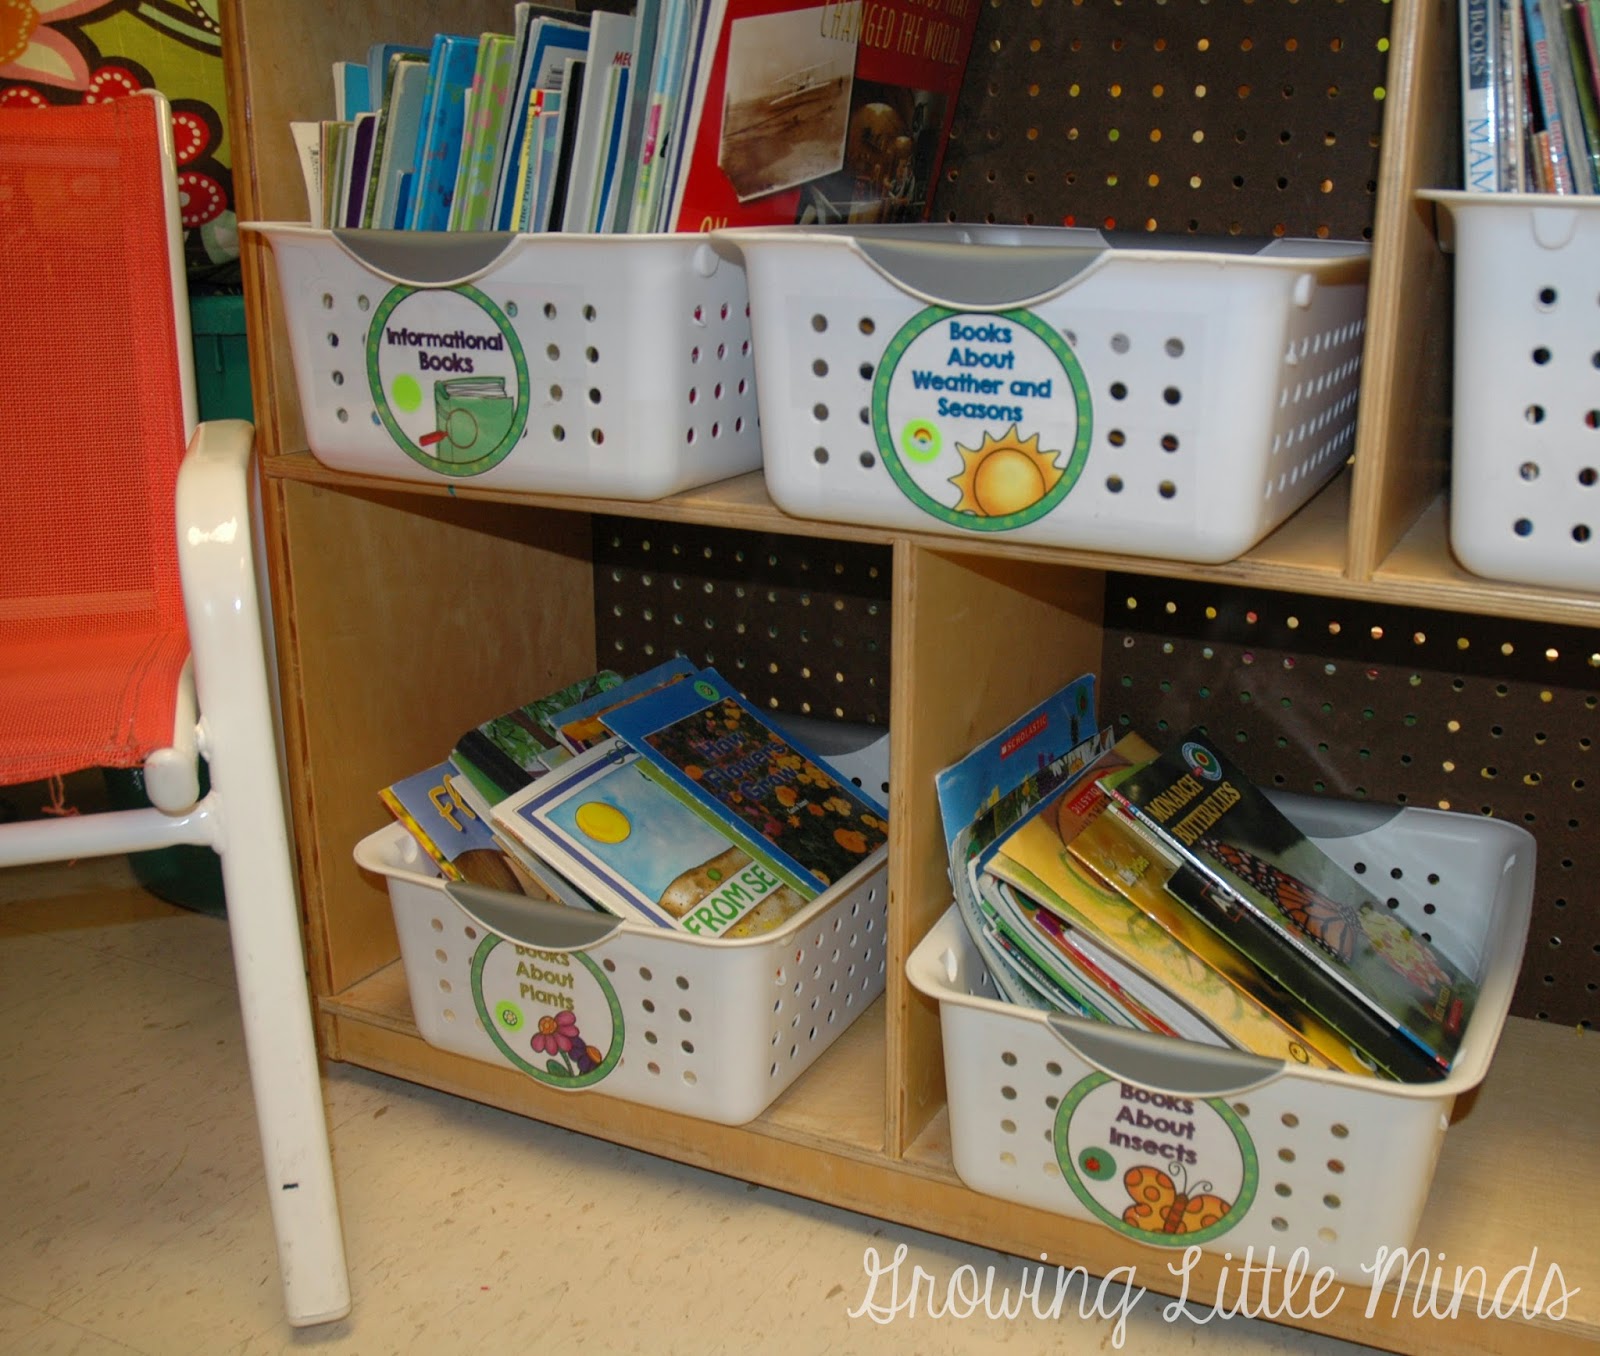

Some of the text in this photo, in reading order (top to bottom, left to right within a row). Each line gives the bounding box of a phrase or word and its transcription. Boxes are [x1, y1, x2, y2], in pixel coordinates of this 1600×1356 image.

[897, 12, 923, 56] THE
[1470, 10, 1486, 77] BOOKS
[386, 327, 504, 352] Informational
[949, 321, 1013, 344] Books
[418, 350, 475, 374] Books
[947, 347, 1016, 370] About
[911, 370, 1053, 399] Weather and
[937, 397, 1023, 423] Seasons
[697, 730, 748, 761] How
[1005, 714, 1048, 752] SCHOLASTIC
[703, 741, 787, 788] Flowers
[739, 765, 799, 800] Grow
[1144, 773, 1204, 823] MONARCH
[1070, 786, 1100, 816] OLASTIC
[1170, 781, 1242, 847] BUTTERFLIES
[682, 864, 779, 935] FROM SE
[516, 961, 575, 989] About
[519, 982, 575, 1011] Plants
[1120, 1083, 1194, 1115] Books
[1115, 1105, 1196, 1140] About
[1109, 1127, 1198, 1165] Insects
